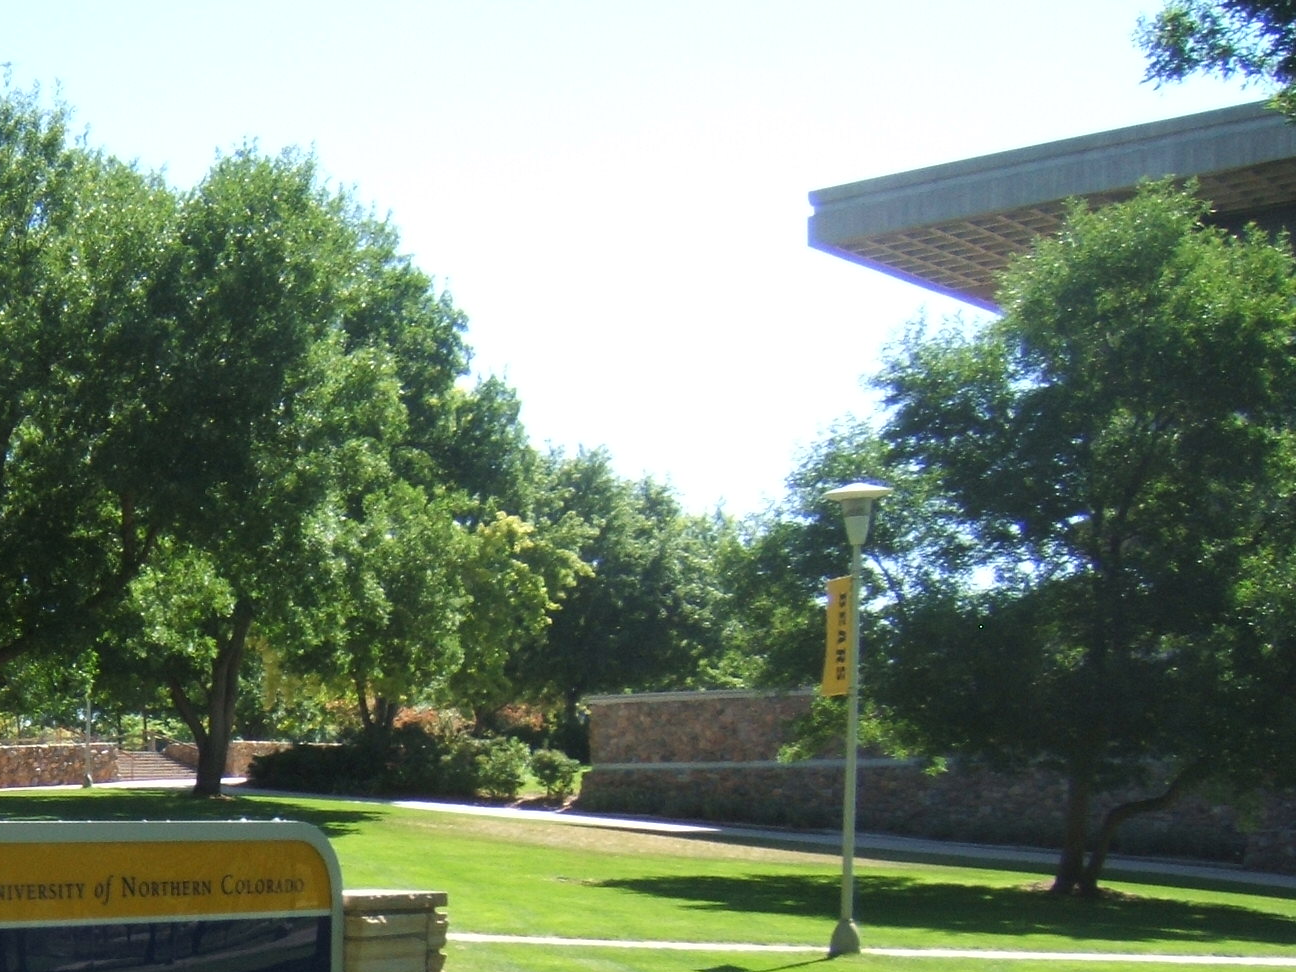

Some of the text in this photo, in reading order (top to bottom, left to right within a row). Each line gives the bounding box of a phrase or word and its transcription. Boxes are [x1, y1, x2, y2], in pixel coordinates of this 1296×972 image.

[94, 874, 114, 905] of
[121, 876, 212, 898] NORTHERN
[221, 874, 304, 896] COLORADO
